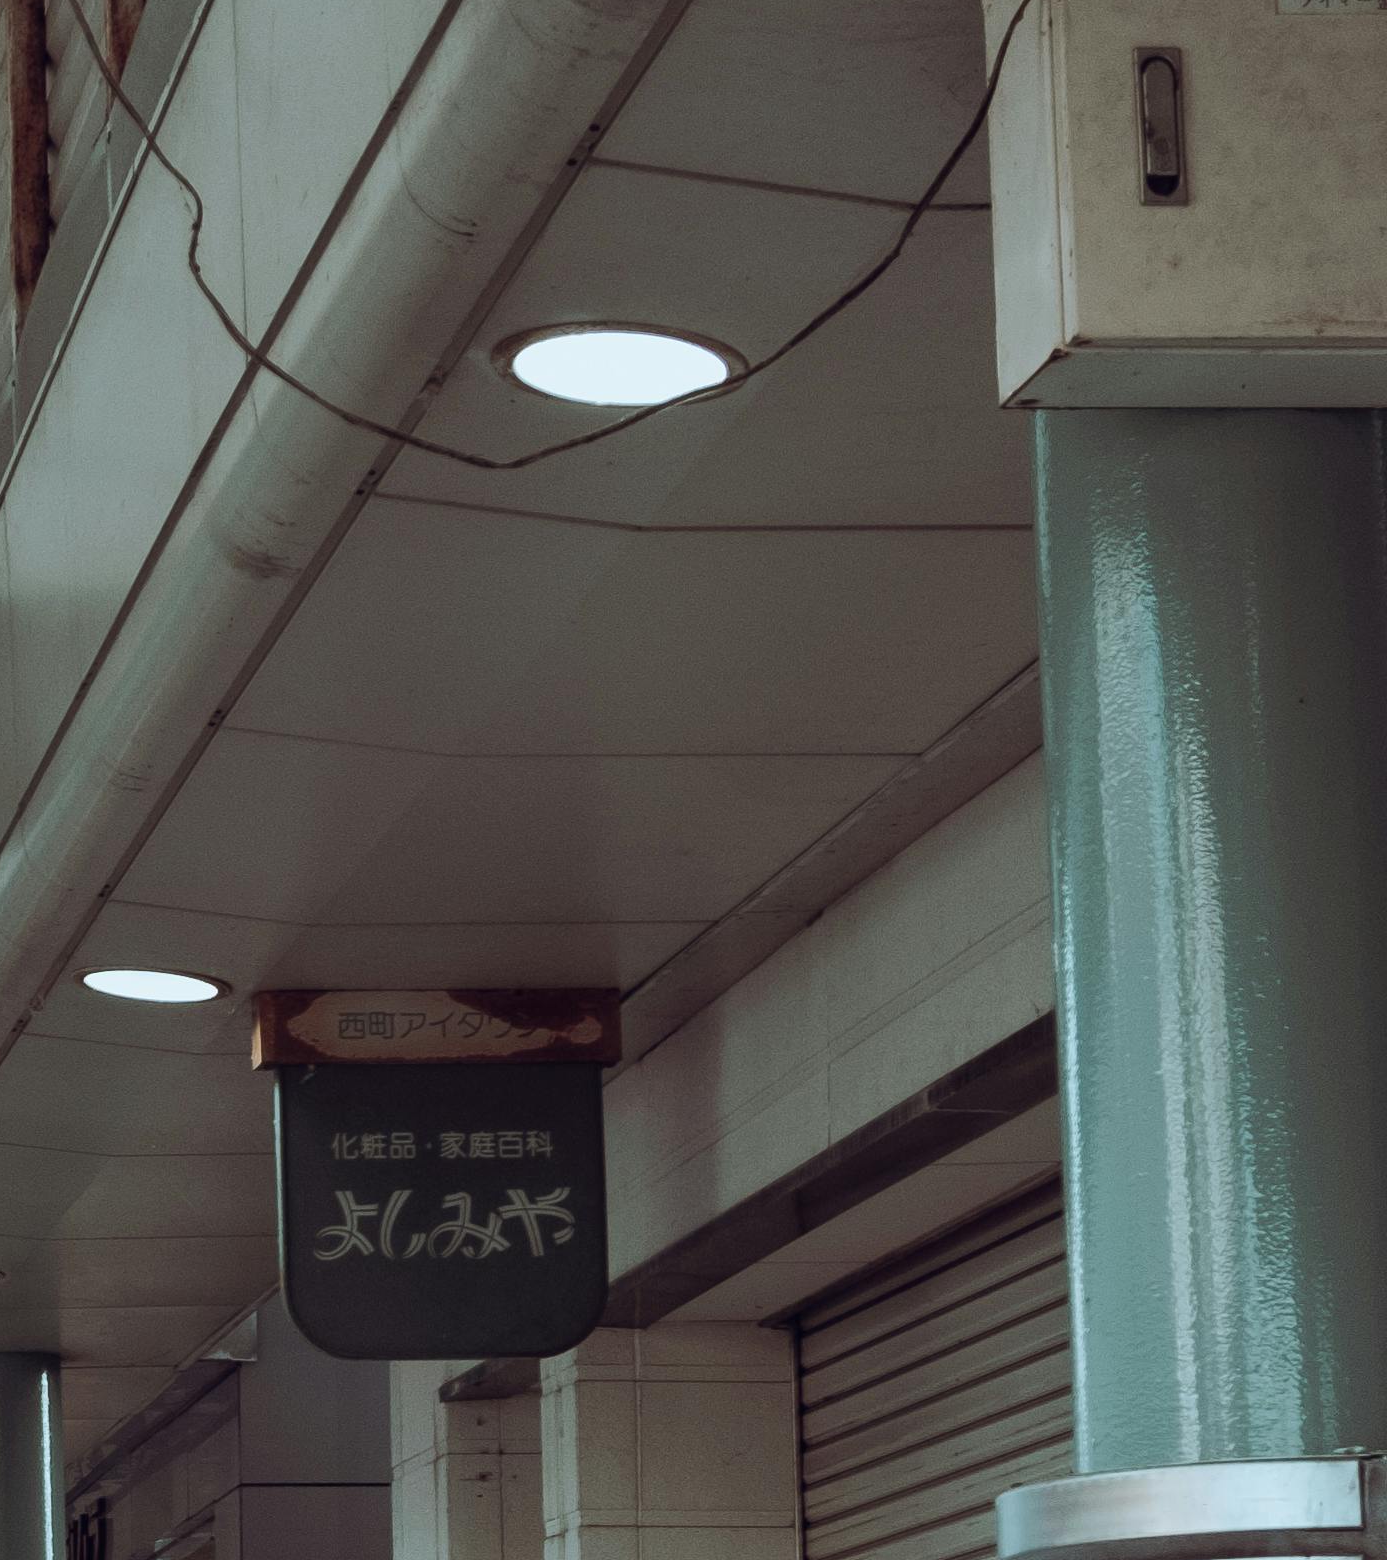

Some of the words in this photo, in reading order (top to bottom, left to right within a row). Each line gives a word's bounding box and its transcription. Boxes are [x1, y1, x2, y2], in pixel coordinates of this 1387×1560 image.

[331, 1131, 554, 1161] 化粧品・家庭百科
[313, 1186, 576, 1261] よしみや
